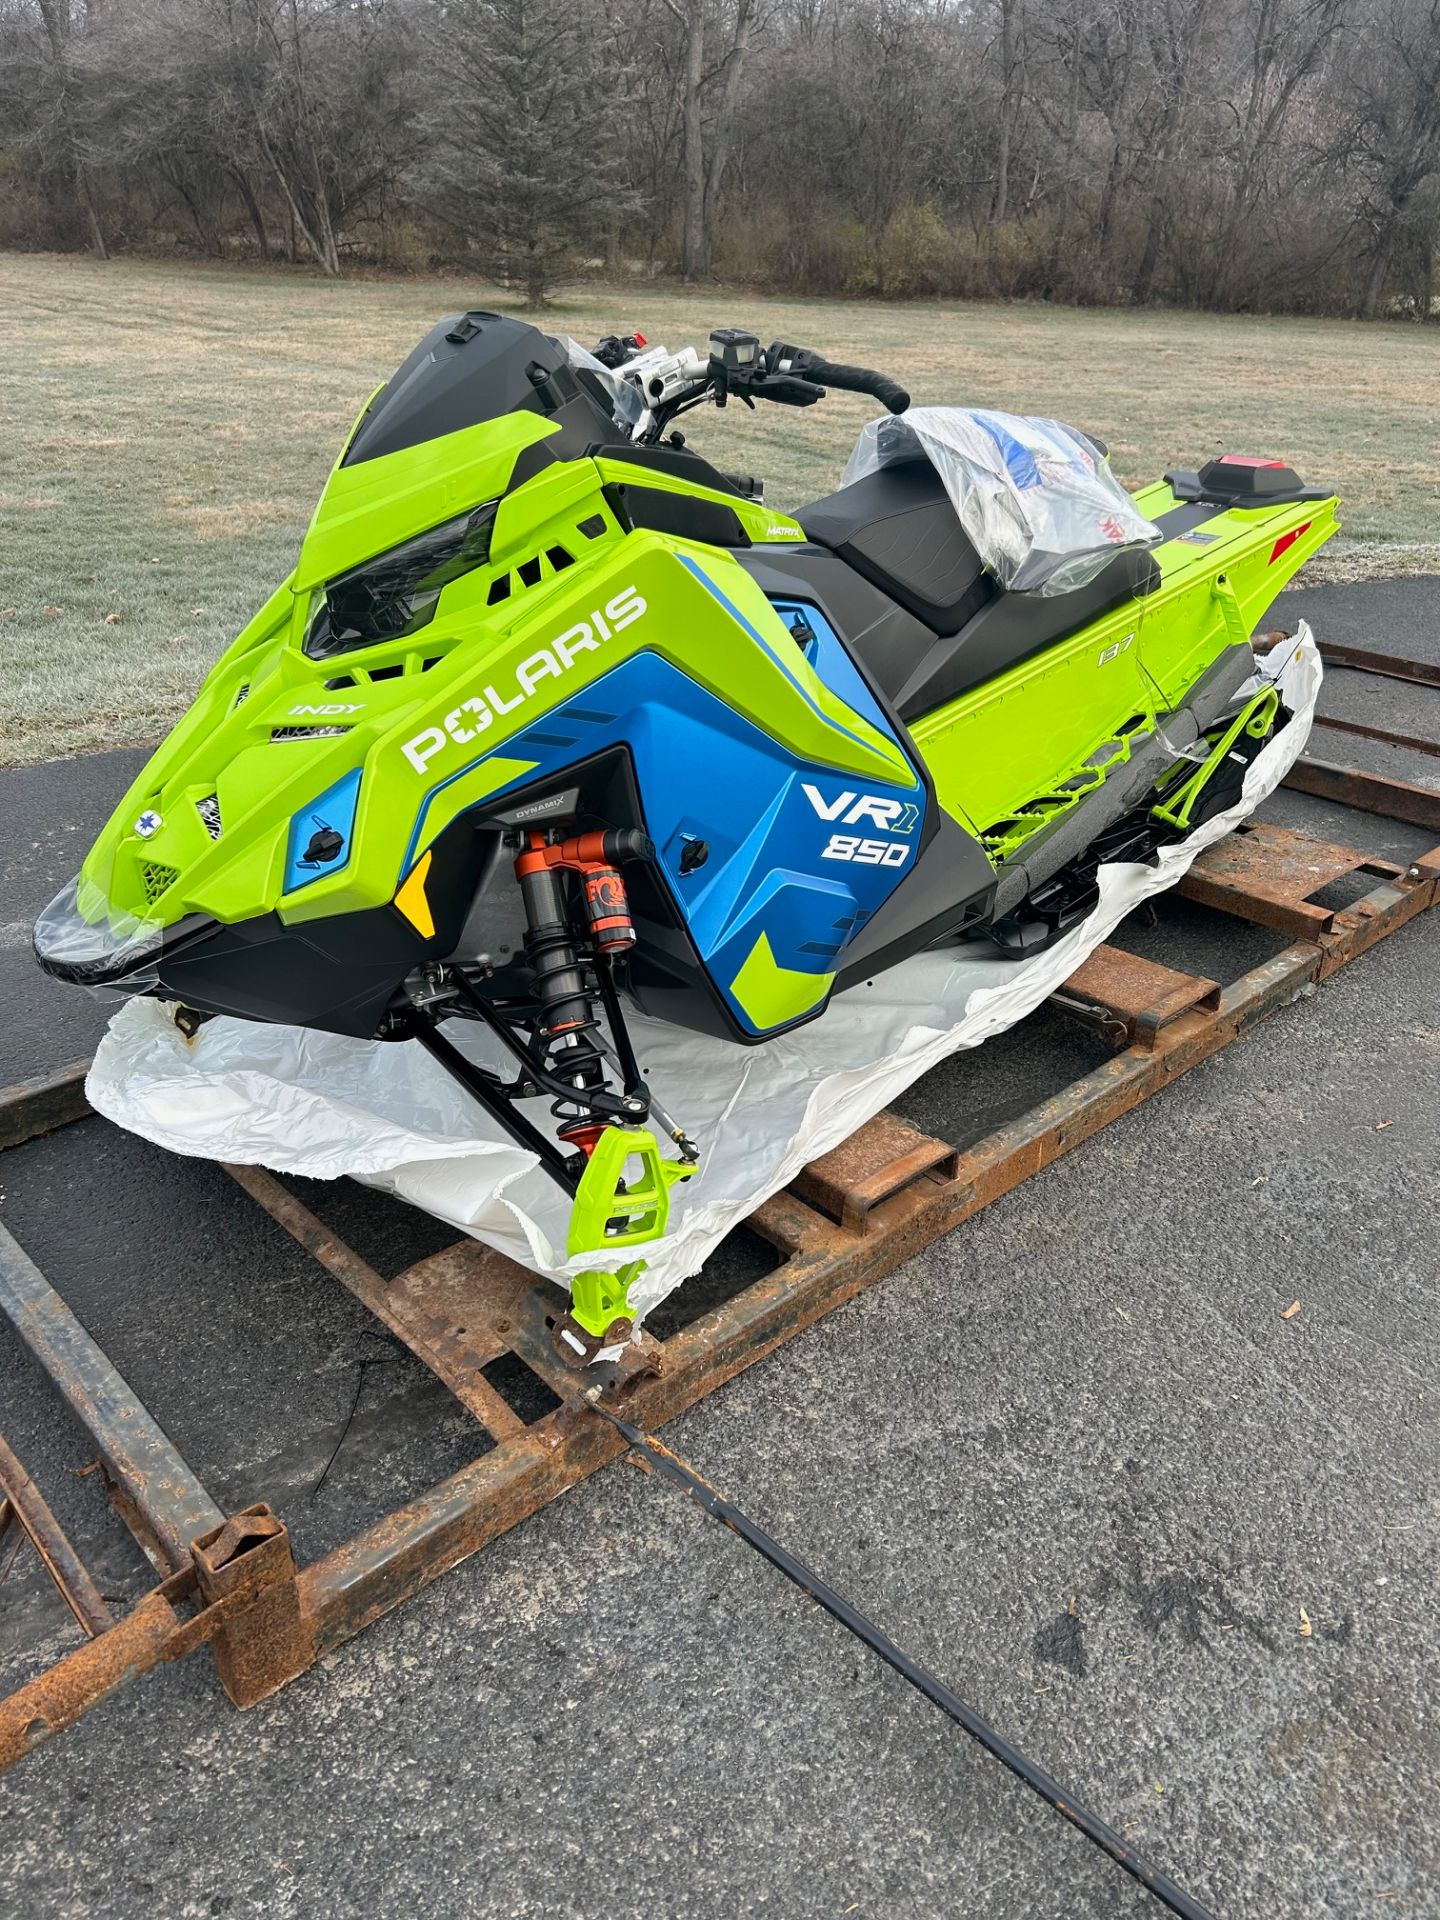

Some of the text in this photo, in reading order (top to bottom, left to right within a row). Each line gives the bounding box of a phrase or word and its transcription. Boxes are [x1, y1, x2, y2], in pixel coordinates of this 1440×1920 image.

[1098, 633, 1135, 667] 137
[400, 585, 647, 775] POLARIS
[287, 704, 368, 715] INDY
[516, 796, 564, 818] DYNAMIX
[801, 783, 919, 834] VR1
[821, 834, 910, 867] 850
